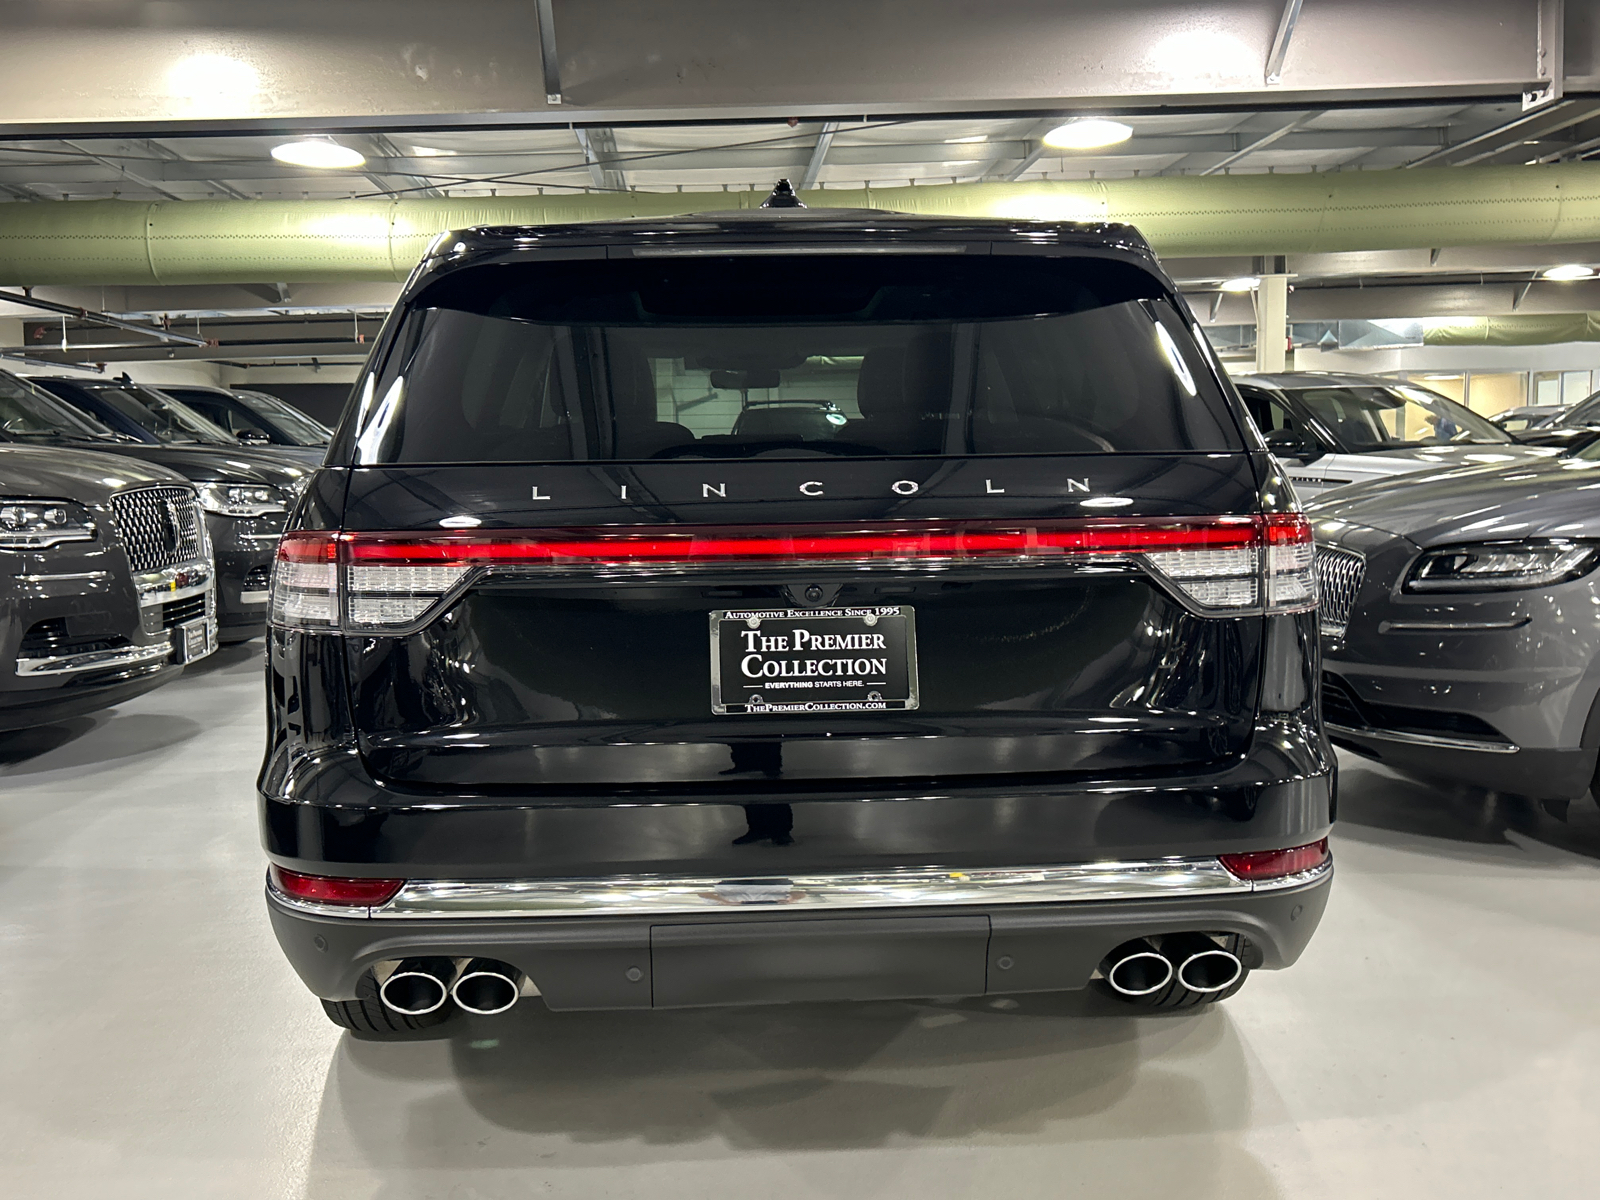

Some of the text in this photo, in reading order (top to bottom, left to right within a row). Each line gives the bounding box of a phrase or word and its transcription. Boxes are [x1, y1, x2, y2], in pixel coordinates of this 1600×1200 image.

[532, 477, 1090, 500] LINCOLN
[787, 609, 843, 618] EXCELLENCE
[845, 608, 872, 616] SINCE
[874, 607, 900, 616] 1995
[741, 629, 886, 652] THE PREMIER
[741, 654, 887, 678] COLLECTION
[765, 681, 813, 689] EVERYTHING
[815, 680, 842, 688] STARTS
